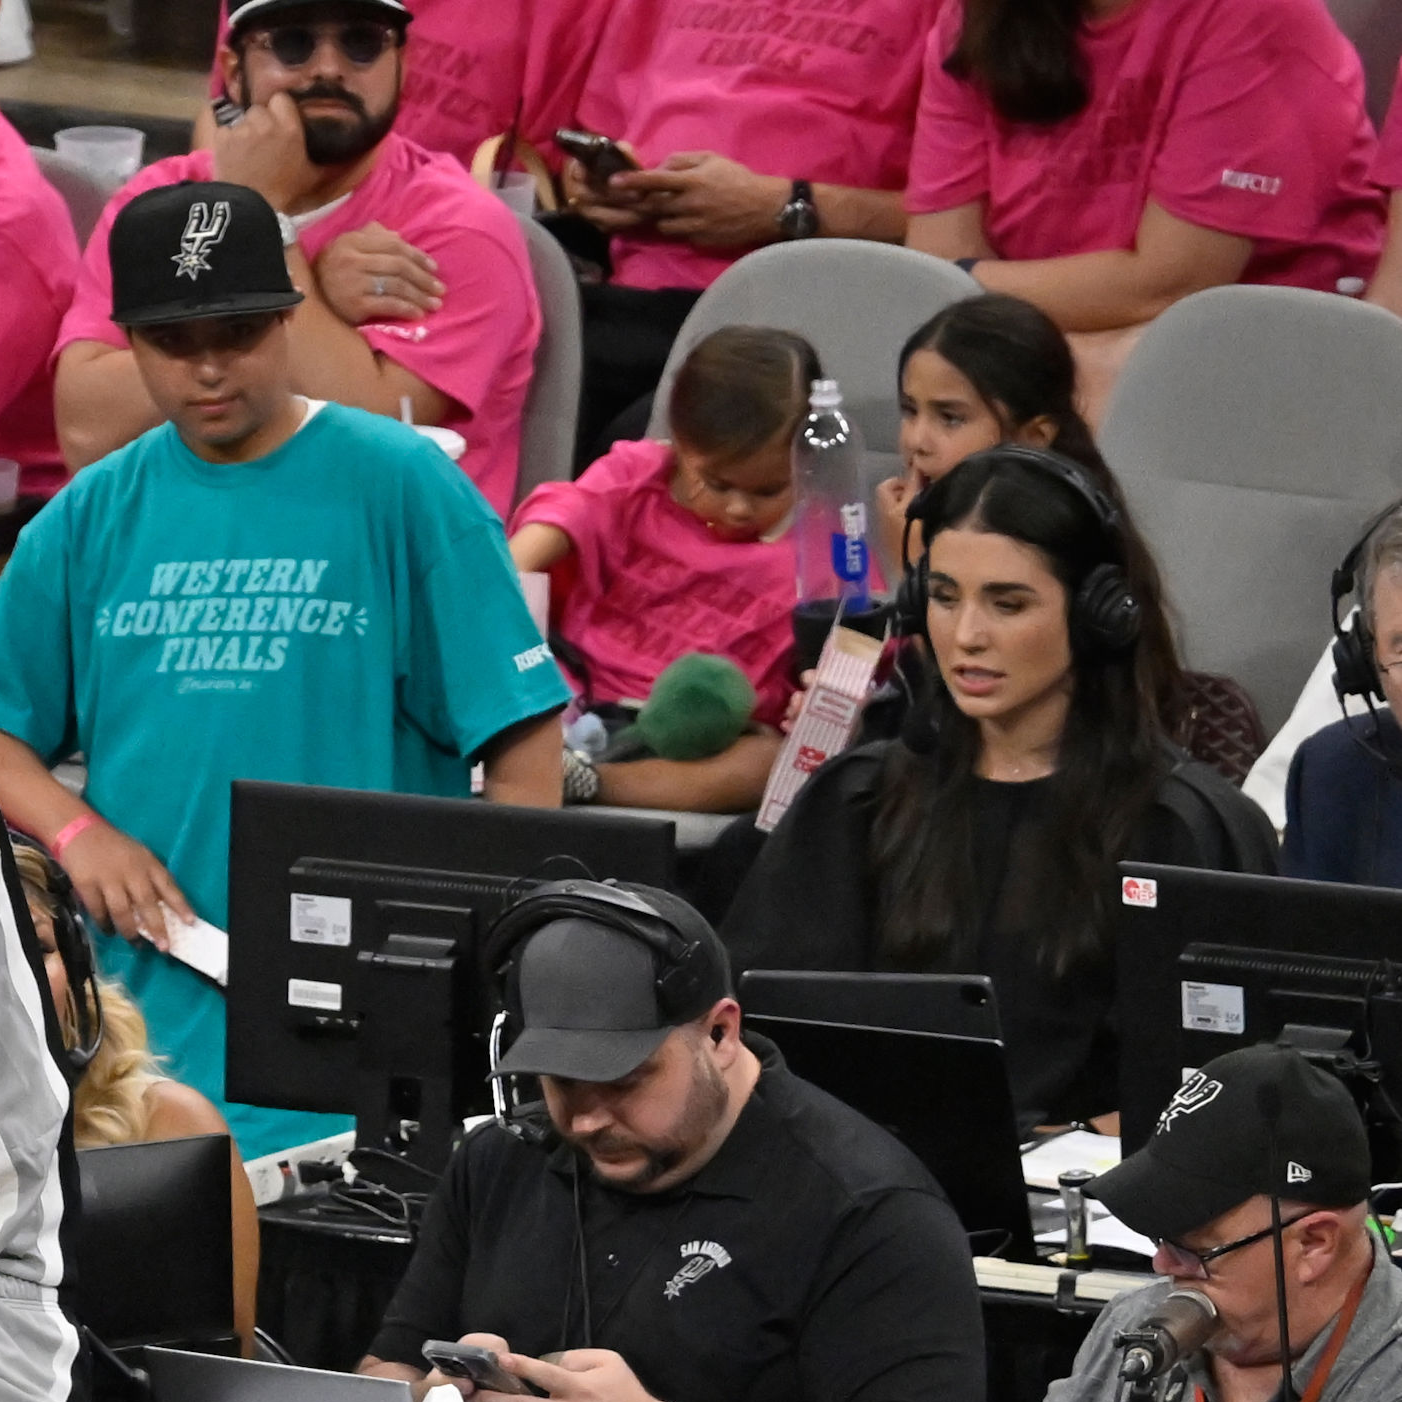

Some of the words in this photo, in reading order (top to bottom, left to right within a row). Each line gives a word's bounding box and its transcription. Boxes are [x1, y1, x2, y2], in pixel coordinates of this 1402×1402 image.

[149, 558, 329, 597] WESTERN
[112, 597, 352, 636] CONFERENCE
[156, 635, 289, 673] FINALS
[680, 1240, 700, 1258] SAN
